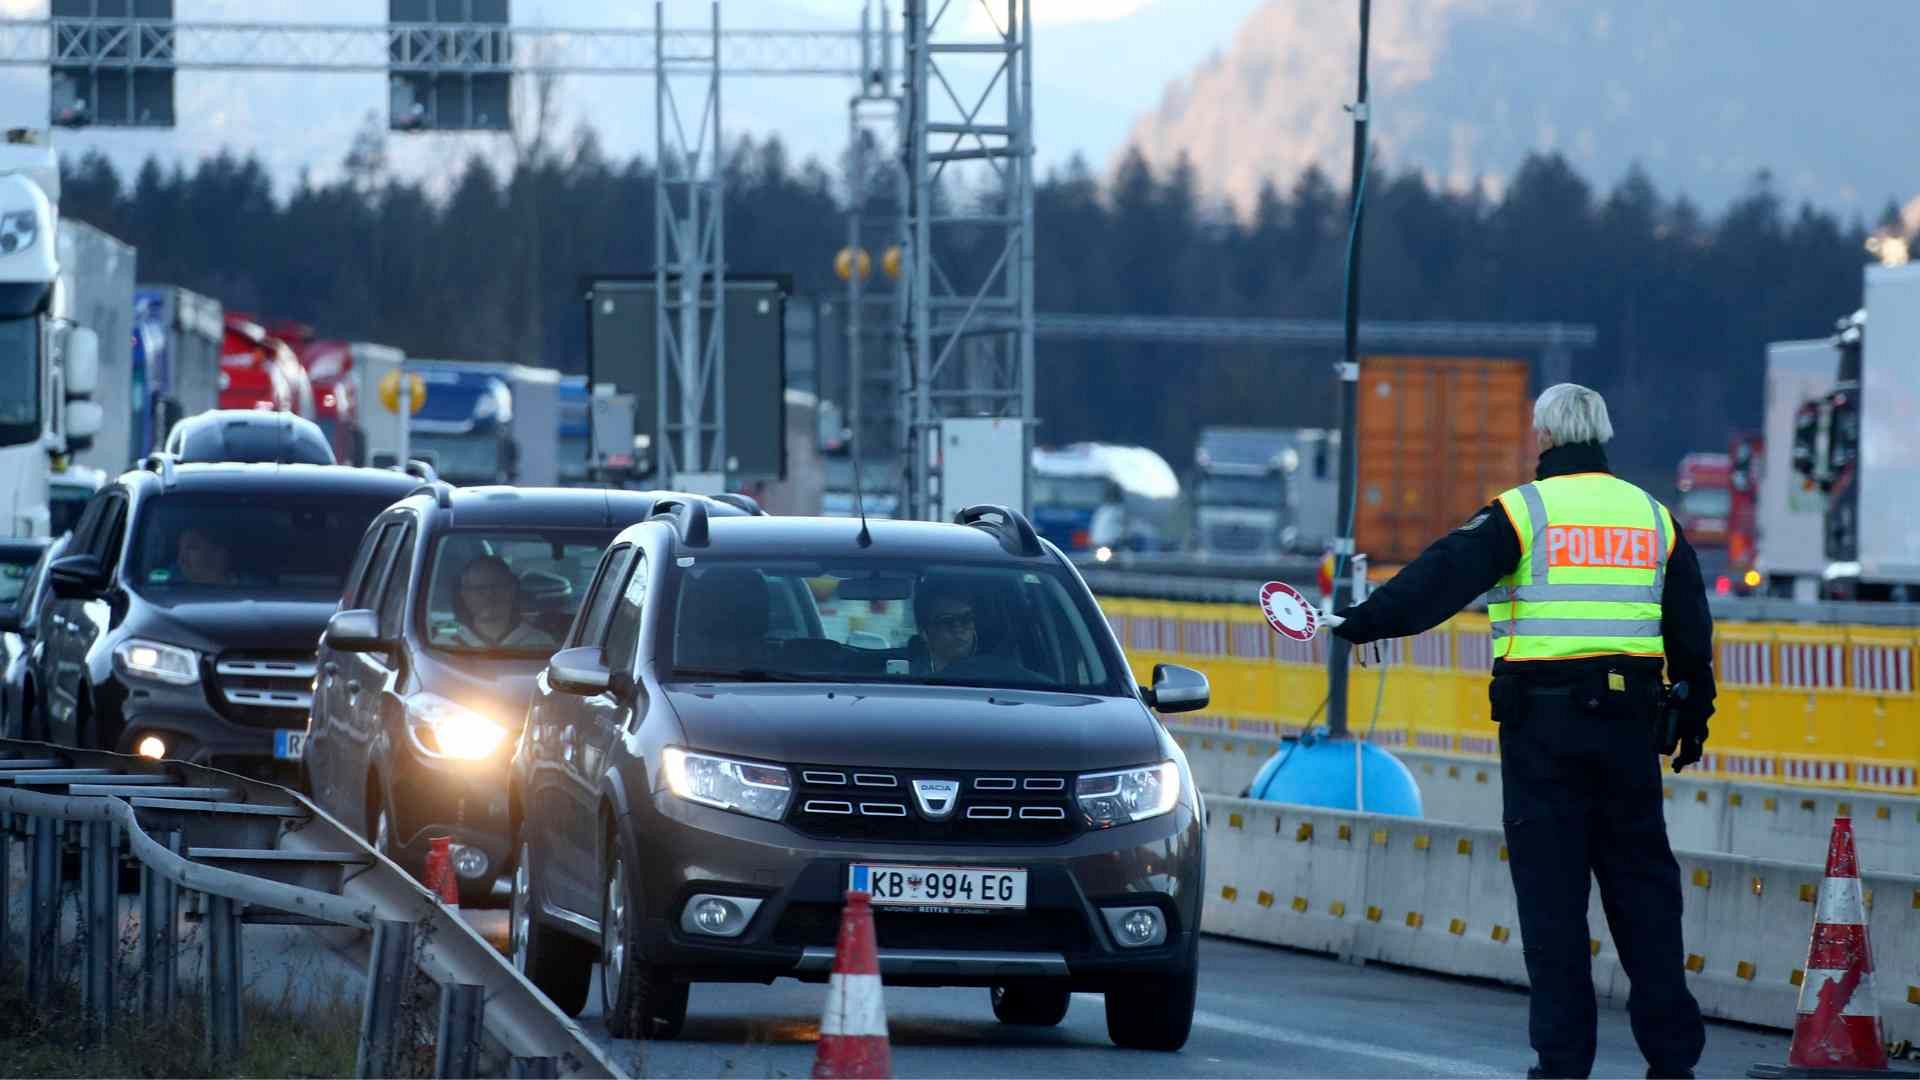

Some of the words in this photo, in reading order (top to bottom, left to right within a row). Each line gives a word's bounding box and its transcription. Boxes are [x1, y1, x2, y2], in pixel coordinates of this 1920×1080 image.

[1549, 526, 1656, 566] POLIZEI
[871, 871, 904, 898] KB
[925, 873, 973, 900] 994
[981, 874, 1014, 901] EG
